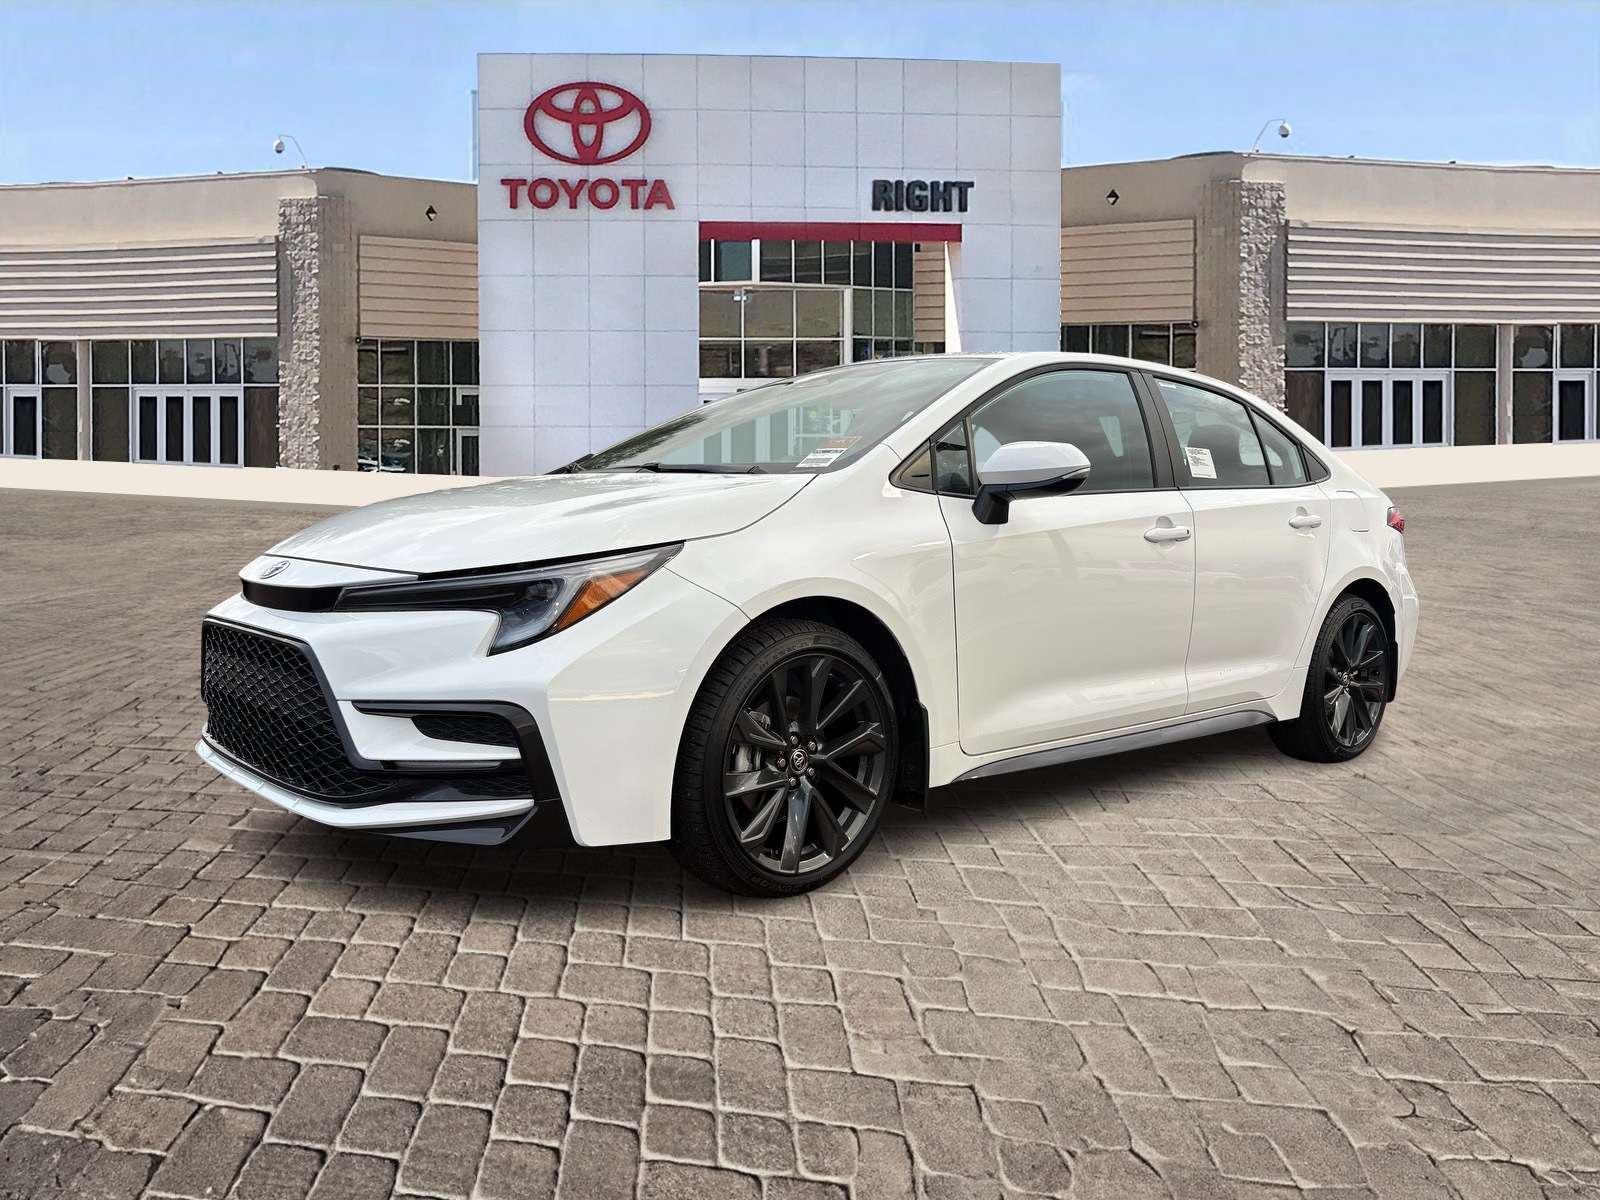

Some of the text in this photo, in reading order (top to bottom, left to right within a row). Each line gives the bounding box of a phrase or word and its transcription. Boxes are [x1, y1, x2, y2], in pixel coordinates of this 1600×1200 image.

[500, 177, 675, 209] TOYOTA
[872, 179, 975, 212] RIGHT
[751, 874, 802, 893] DUNLOP
